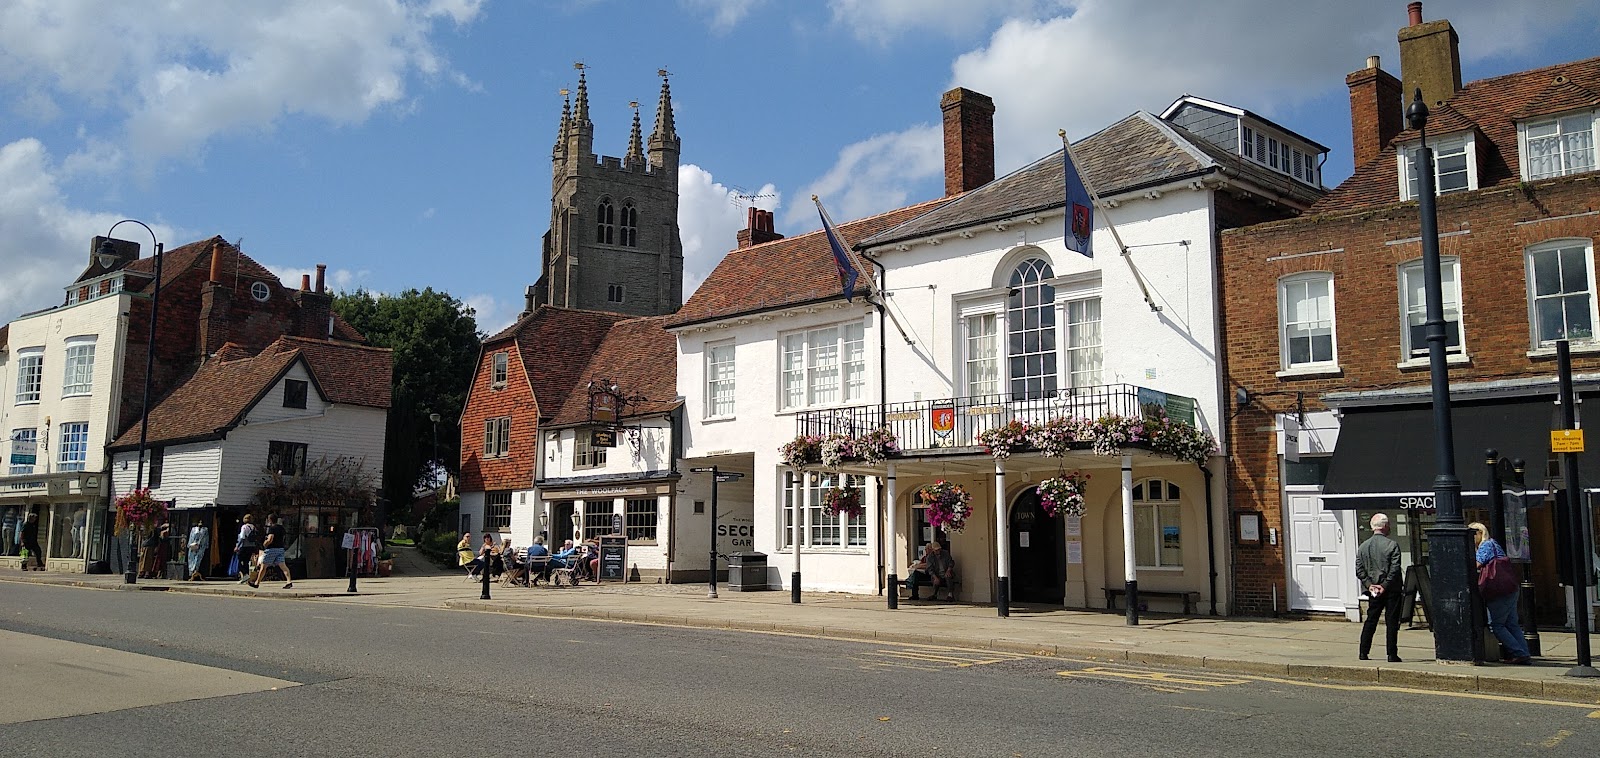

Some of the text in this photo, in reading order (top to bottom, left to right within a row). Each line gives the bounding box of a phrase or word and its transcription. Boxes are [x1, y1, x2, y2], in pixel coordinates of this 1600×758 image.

[888, 413, 918, 421] TOWN
[591, 487, 628, 495] WOOLPACK
[1016, 512, 1035, 520] TOWN
[732, 539, 752, 547] GAR
